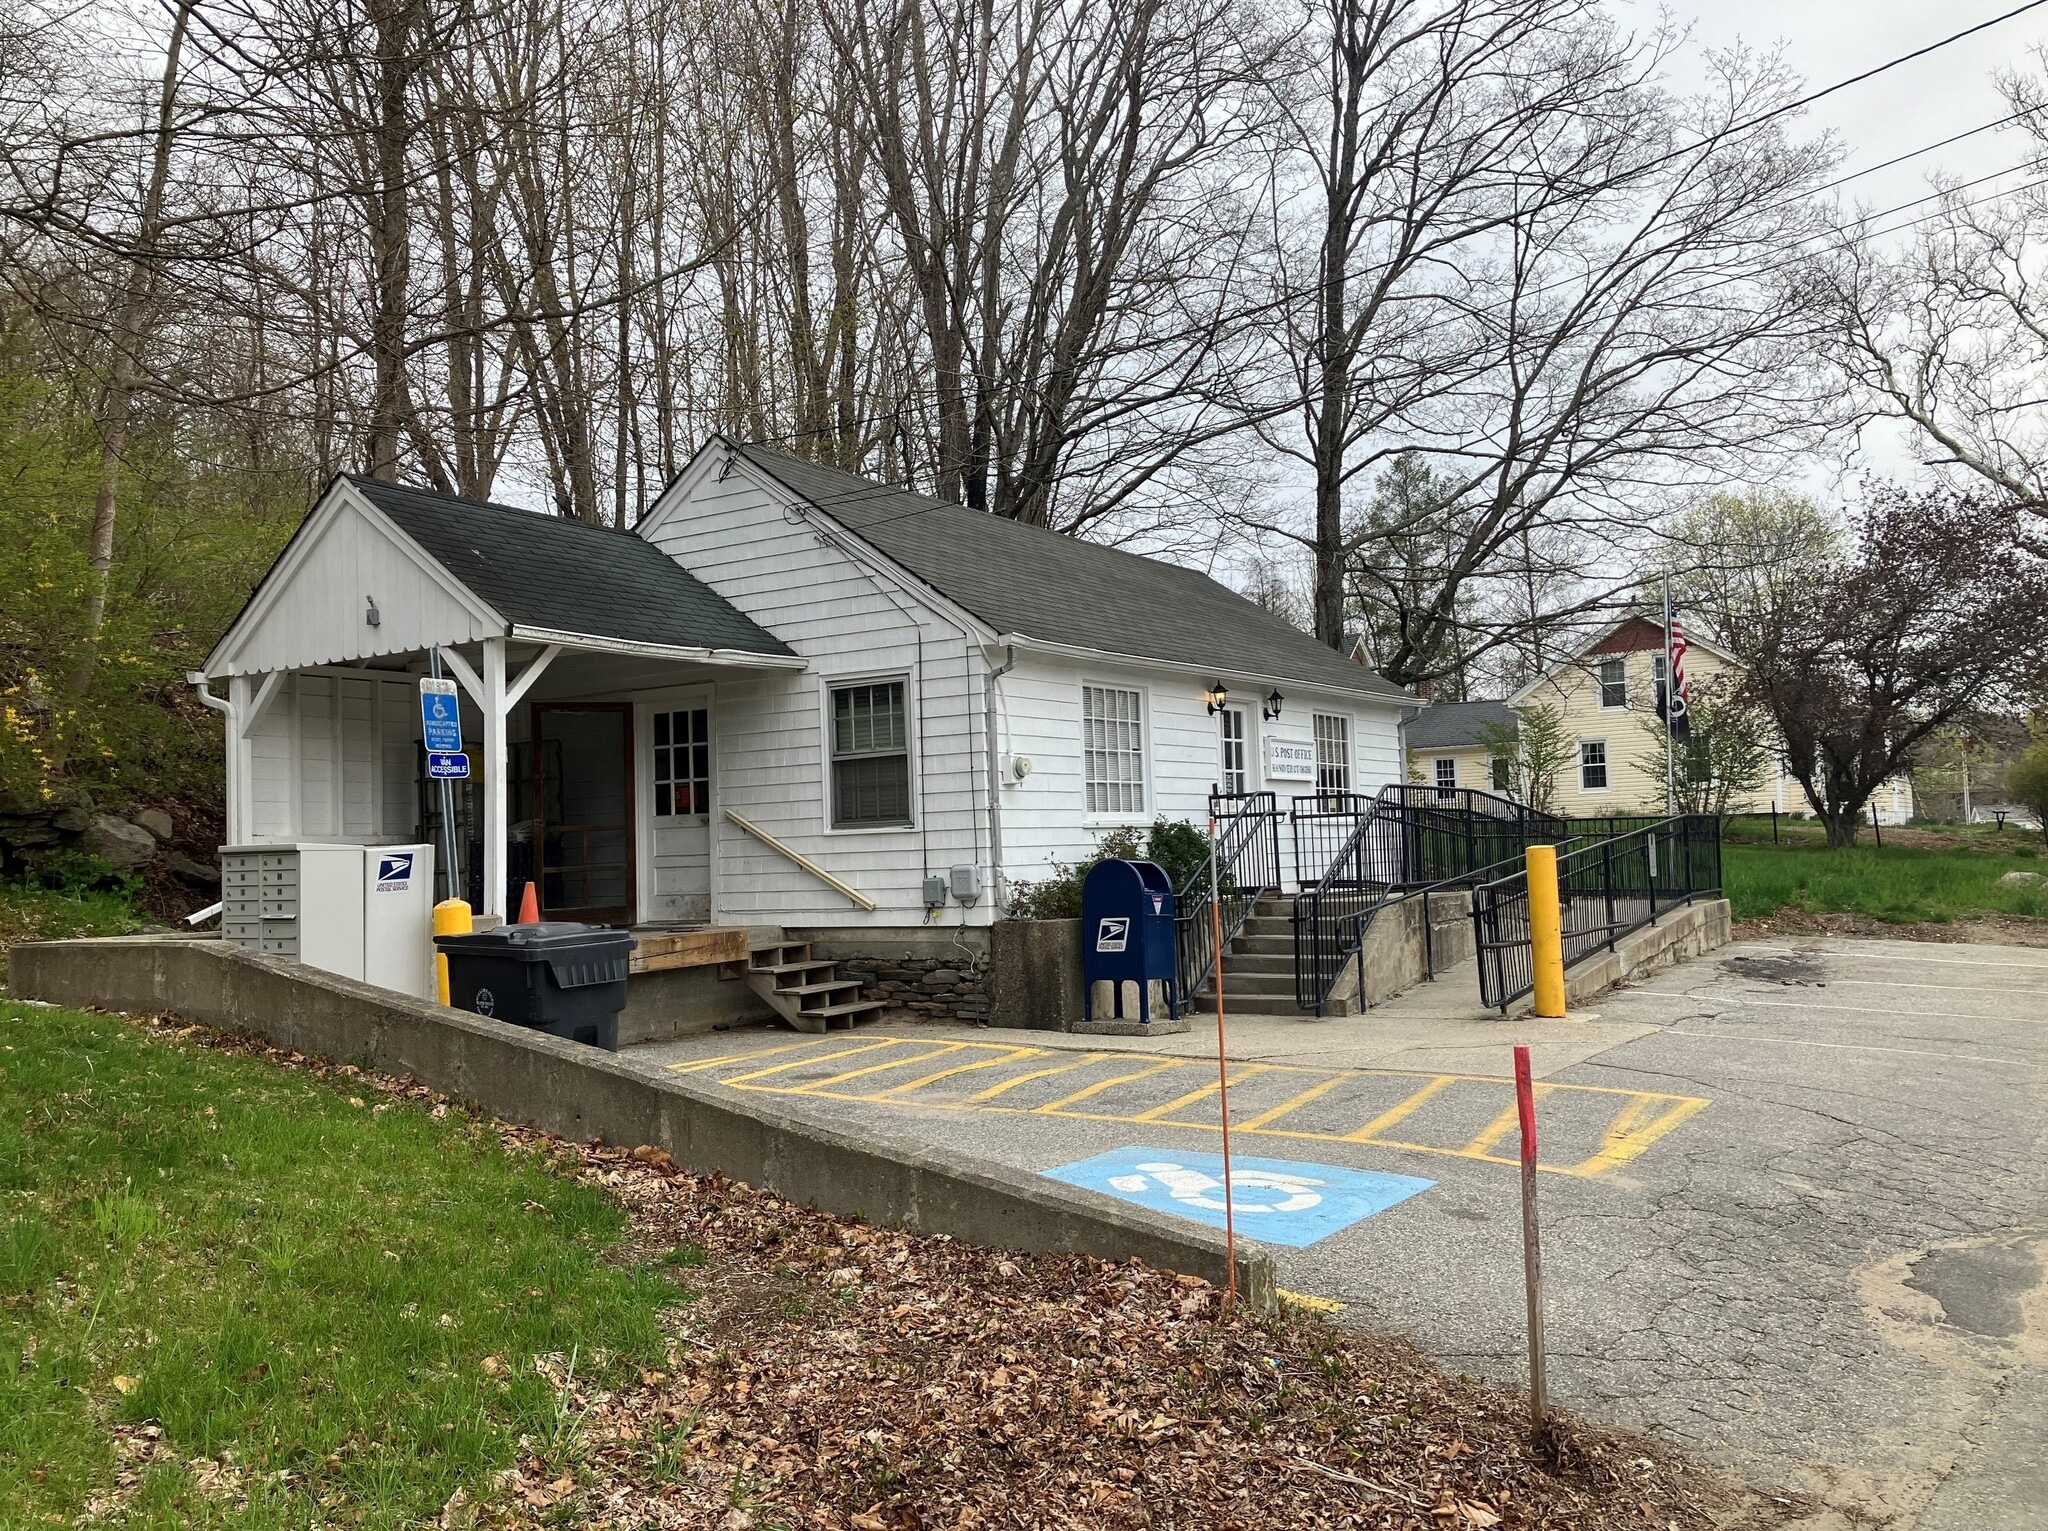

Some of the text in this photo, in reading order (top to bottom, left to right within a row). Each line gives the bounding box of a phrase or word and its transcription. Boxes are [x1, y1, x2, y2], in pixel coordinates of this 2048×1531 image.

[426, 720, 457, 728] HANDICAPPED
[428, 728, 456, 737] PARKING
[1280, 748, 1293, 759] POST
[1294, 749, 1311, 760] OFFICE
[431, 765, 467, 774] ACCESSIBLE
[1272, 764, 1293, 773] HANOVER
